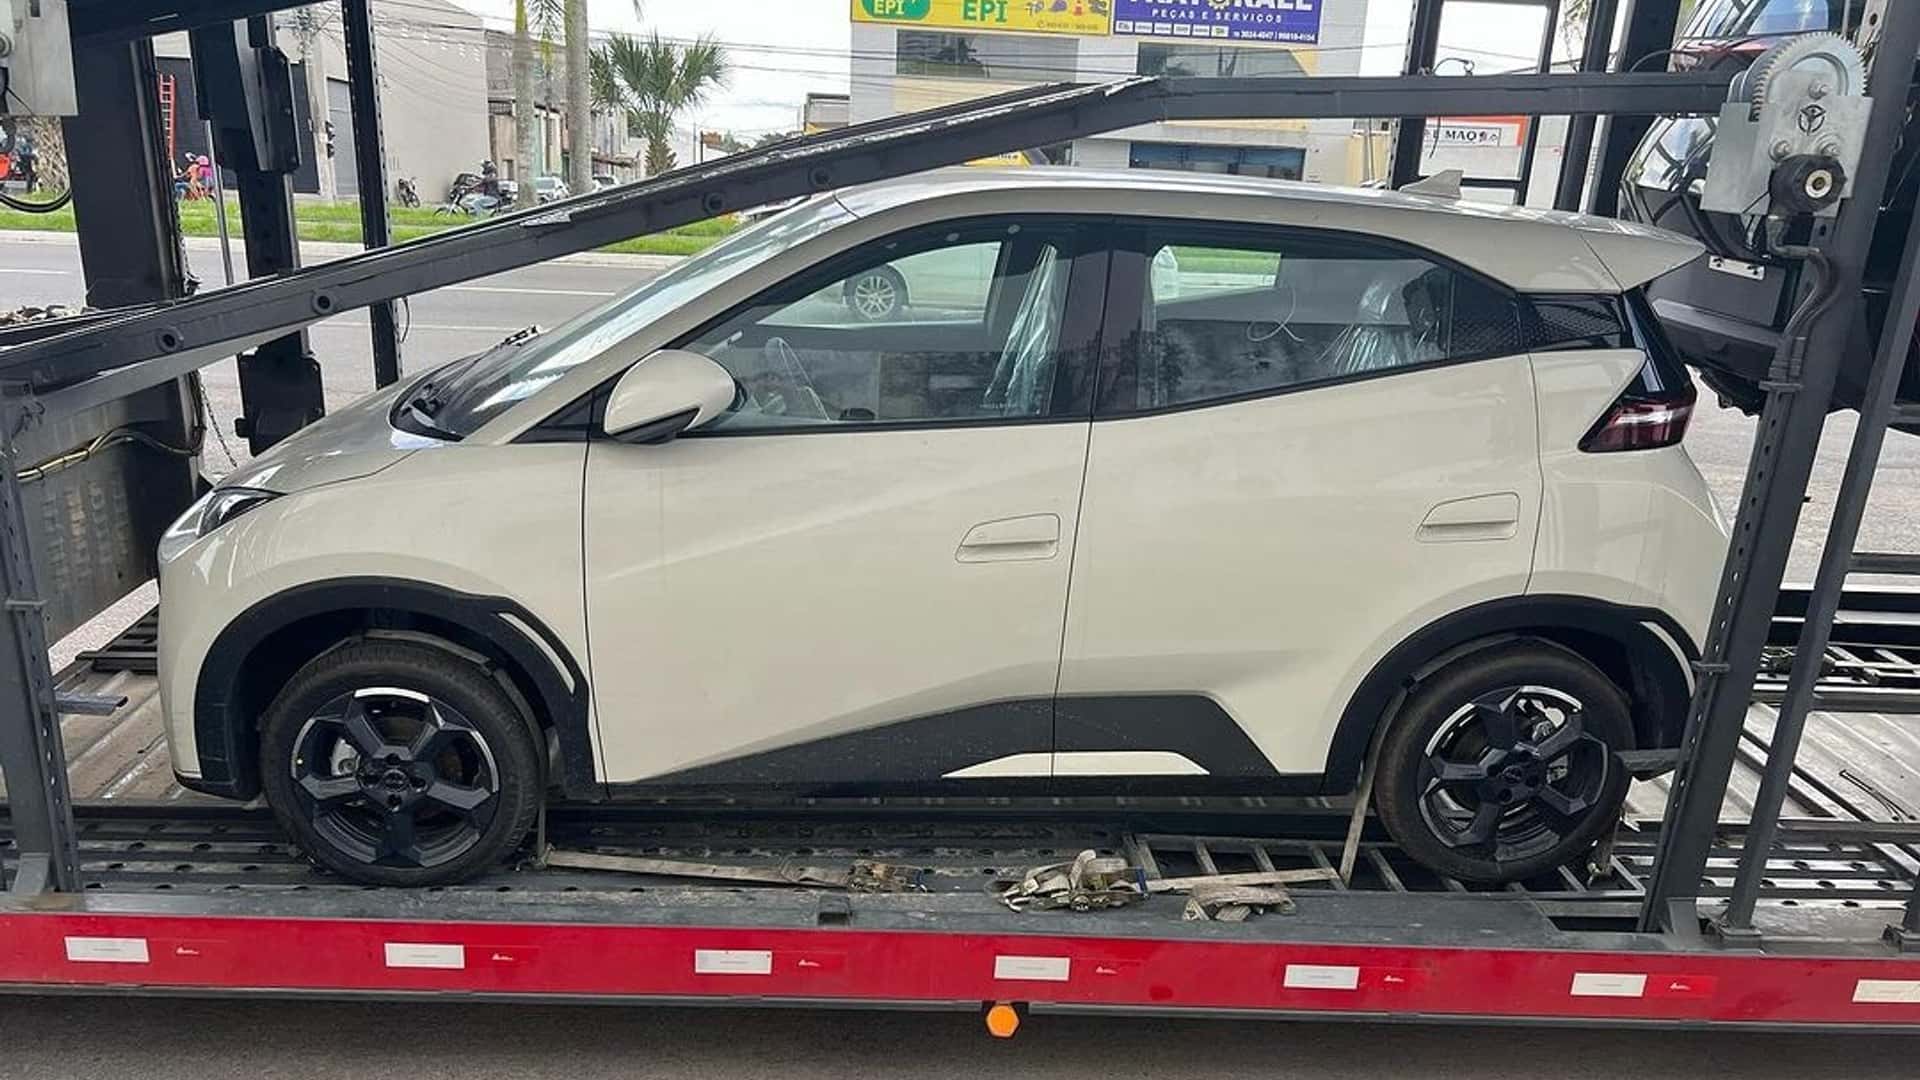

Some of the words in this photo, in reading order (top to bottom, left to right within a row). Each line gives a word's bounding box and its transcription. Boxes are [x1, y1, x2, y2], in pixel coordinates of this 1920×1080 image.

[873, 0, 905, 15] EPI
[962, 0, 1009, 23] EPI
[1152, 8, 1195, 19] PEÇAS
[1202, 11, 1209, 20] E
[1215, 12, 1282, 23] SERVIÇOS
